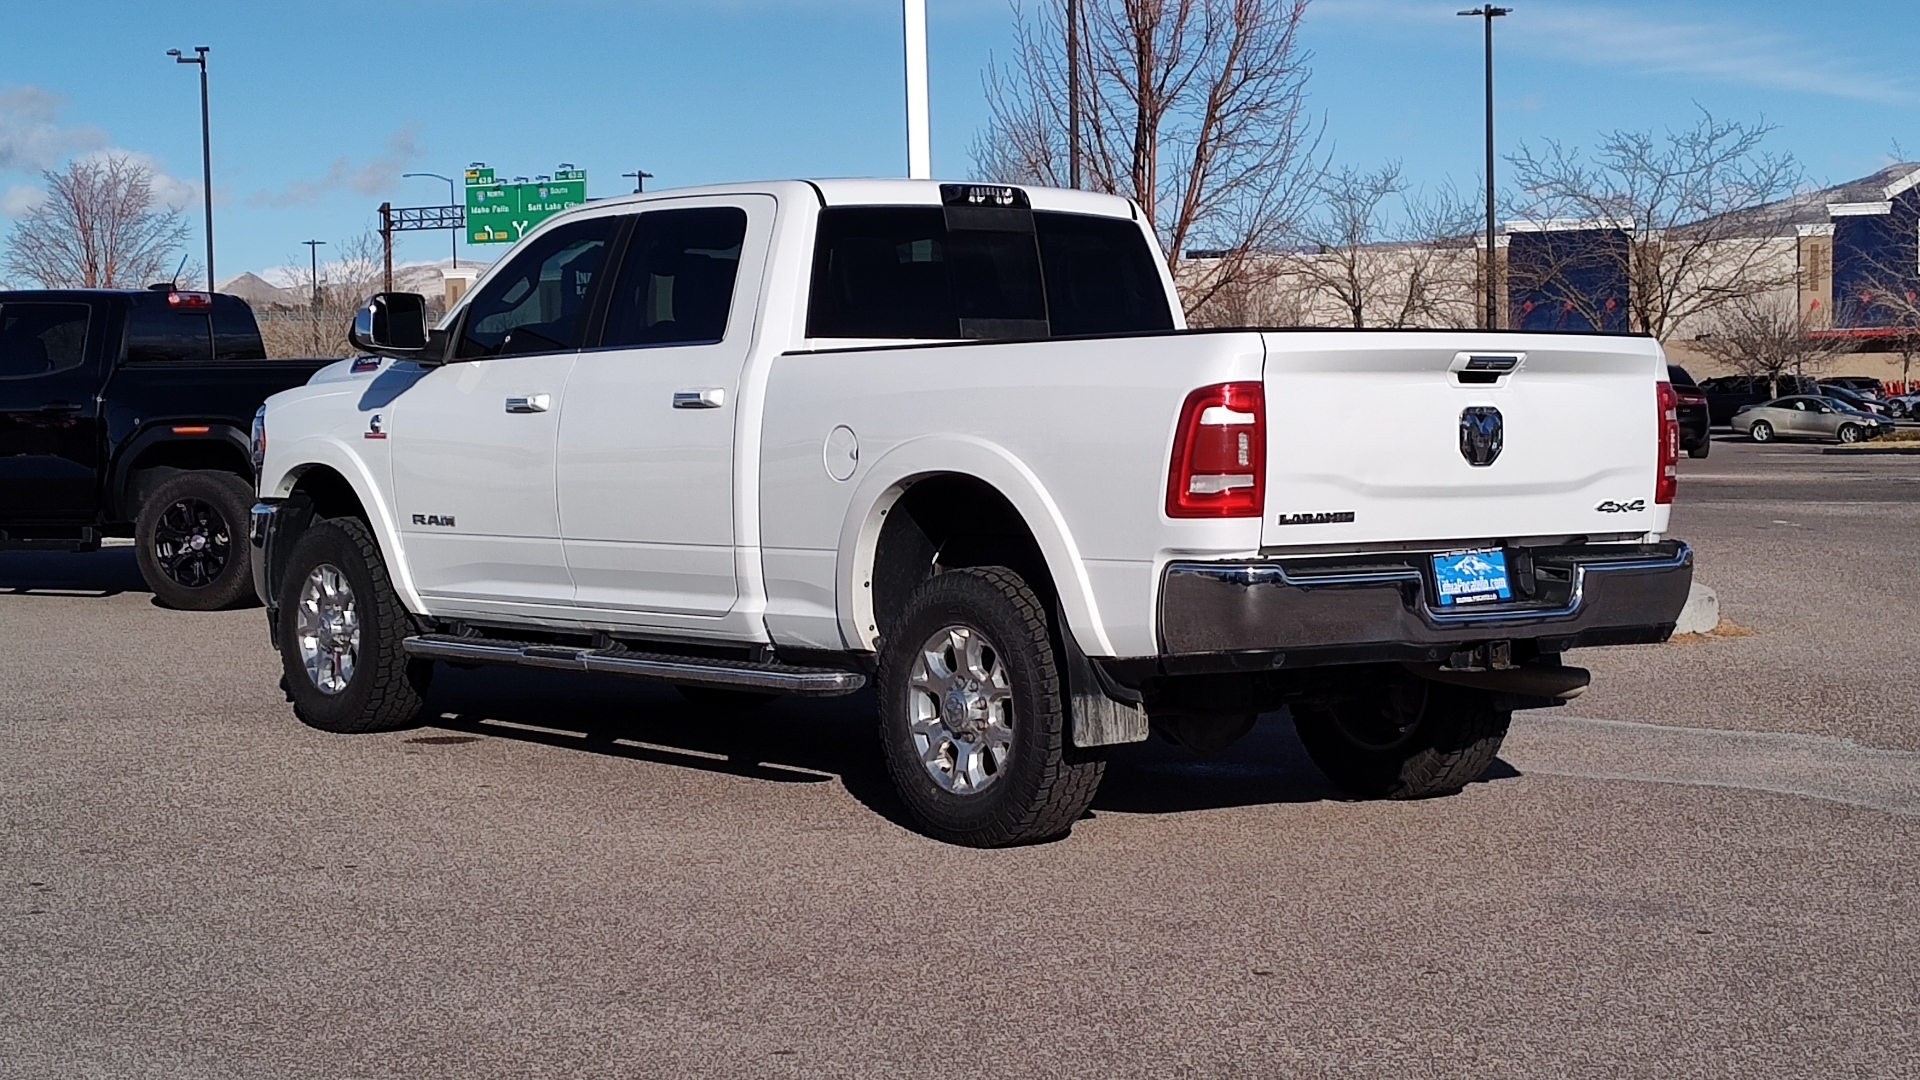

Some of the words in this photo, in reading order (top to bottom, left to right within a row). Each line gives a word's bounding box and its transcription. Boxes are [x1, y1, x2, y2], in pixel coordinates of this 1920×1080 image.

[471, 206, 490, 214] Idaho
[492, 204, 510, 213] Falls
[527, 203, 542, 211] Salt
[545, 202, 562, 210] Lake
[412, 514, 456, 527] RAM
[1278, 511, 1355, 526] LARAMIE
